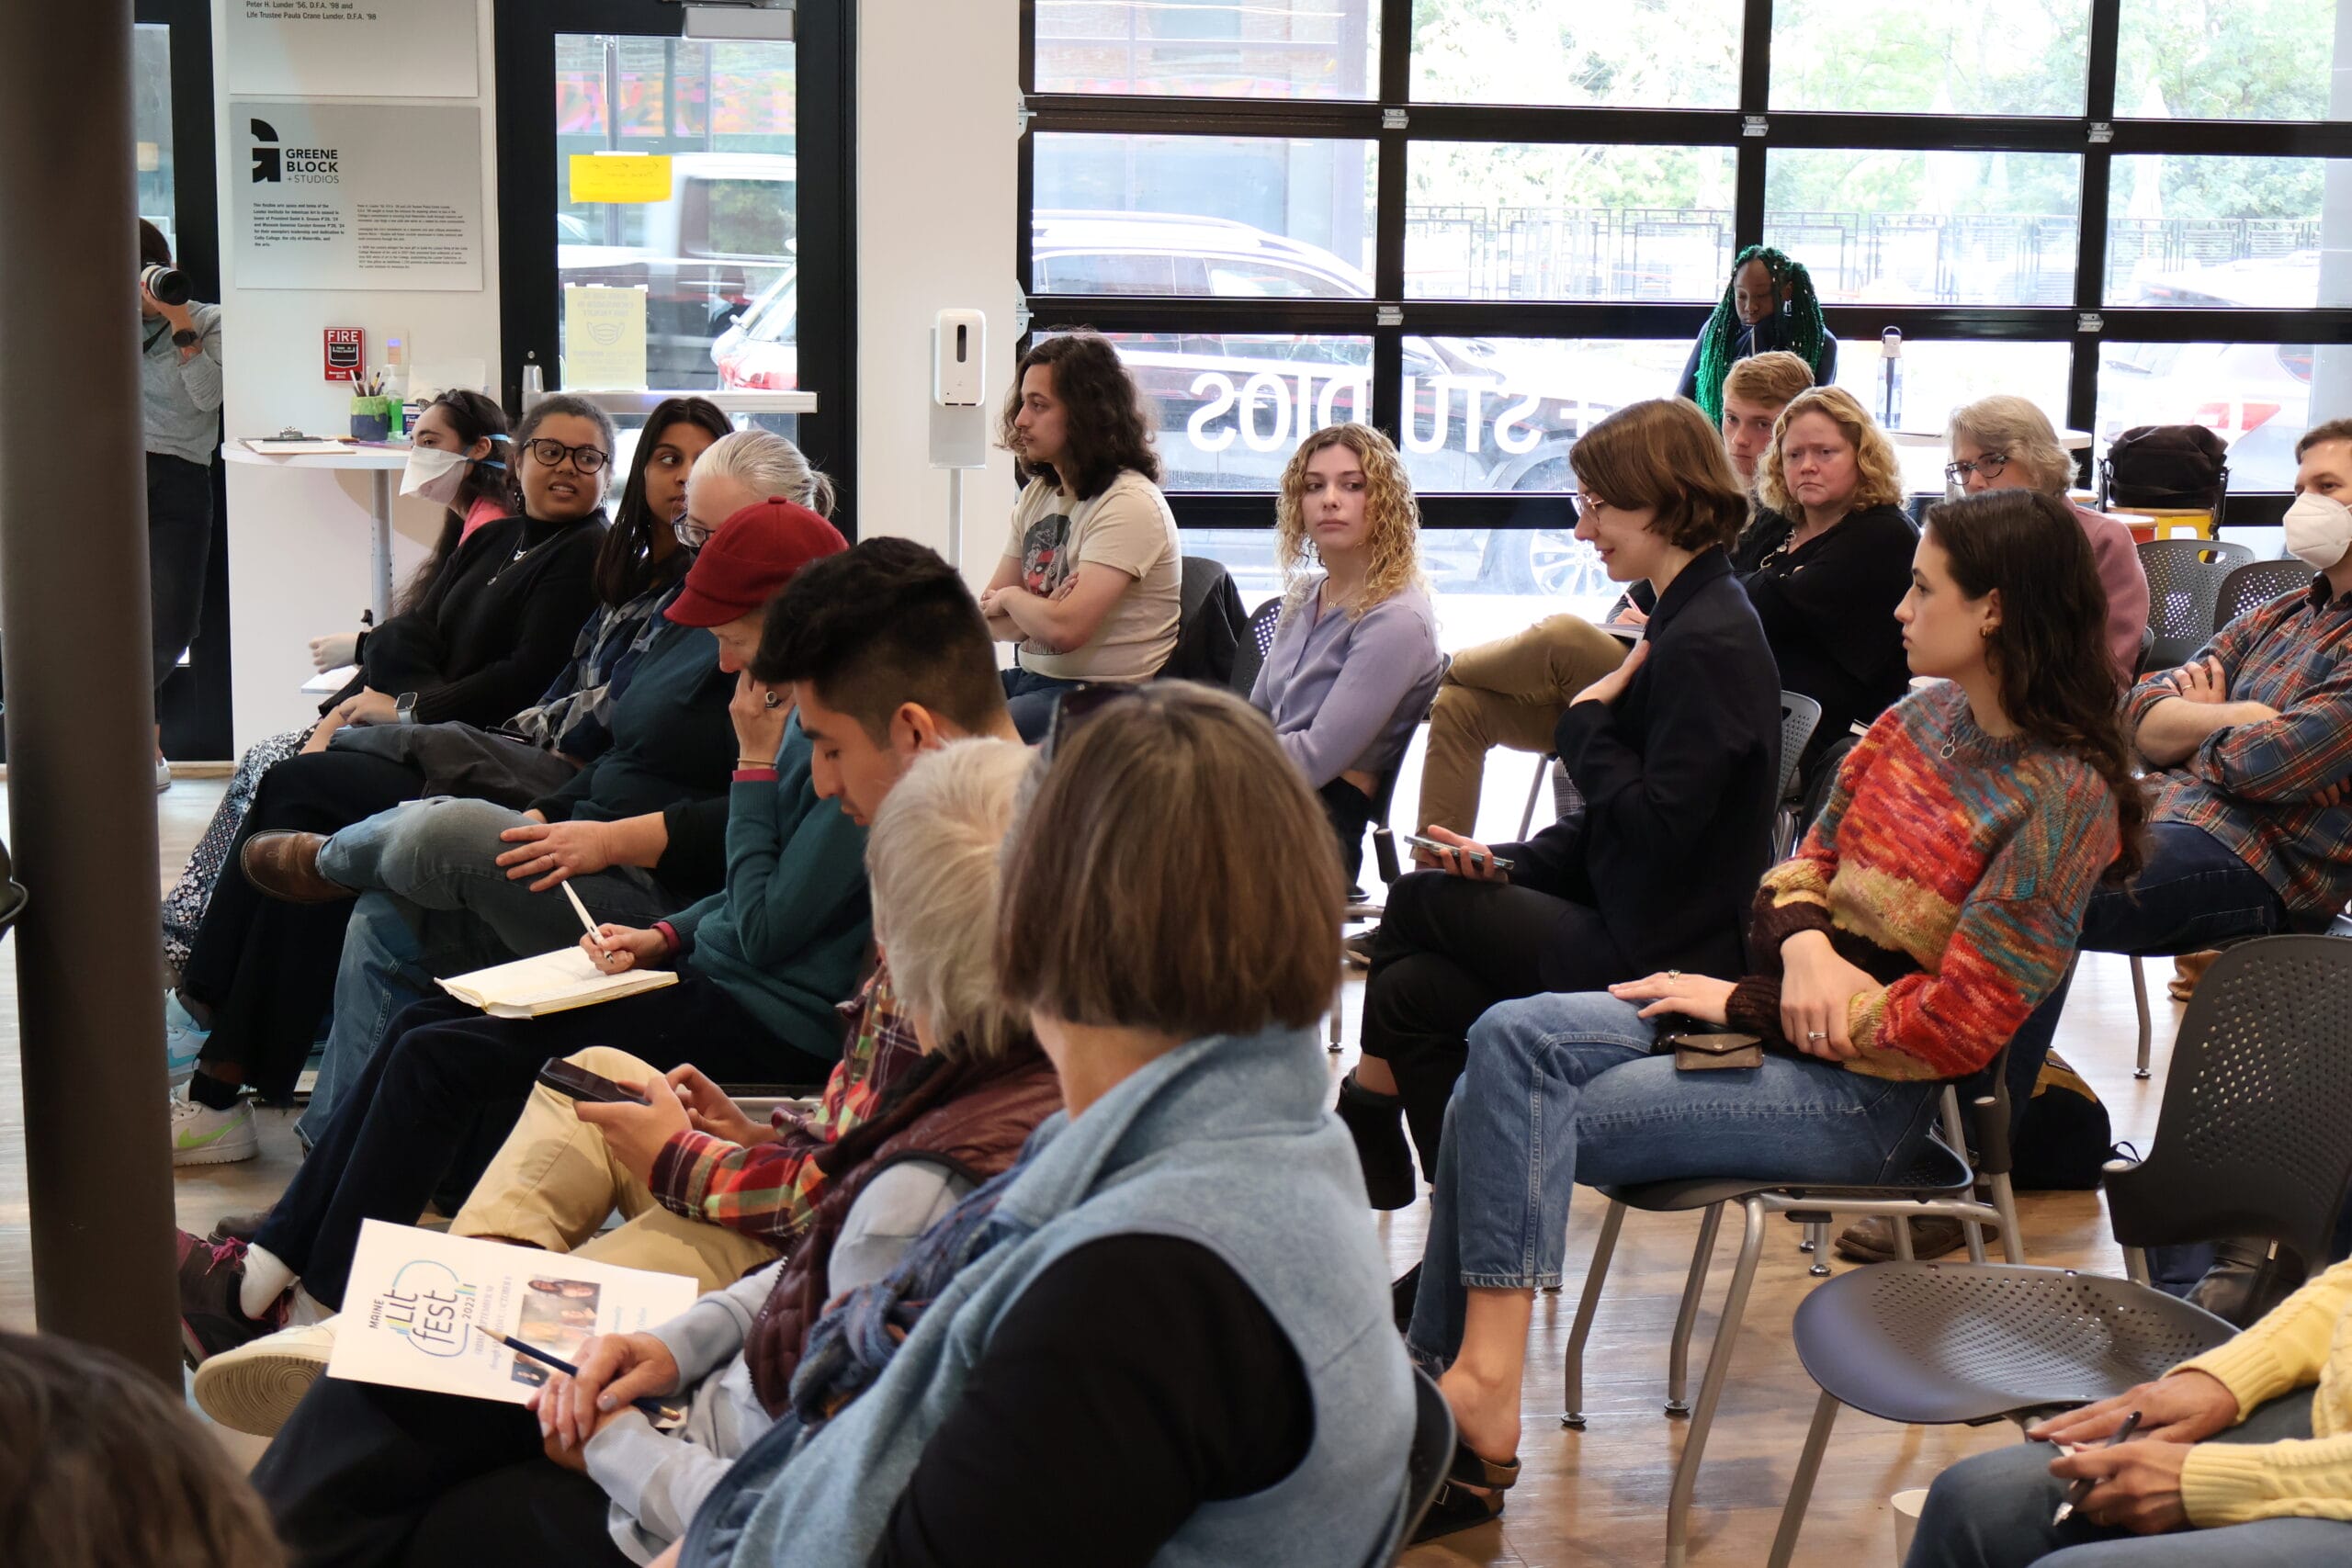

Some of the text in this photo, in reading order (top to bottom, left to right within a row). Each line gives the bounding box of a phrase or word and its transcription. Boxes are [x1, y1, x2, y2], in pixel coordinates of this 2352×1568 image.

[286, 148, 338, 159] GREENE
[287, 161, 339, 173] BLOCK
[328, 331, 358, 342] FIRE
[461, 1296, 476, 1320] 2022
[368, 1299, 385, 1330] MAINE
